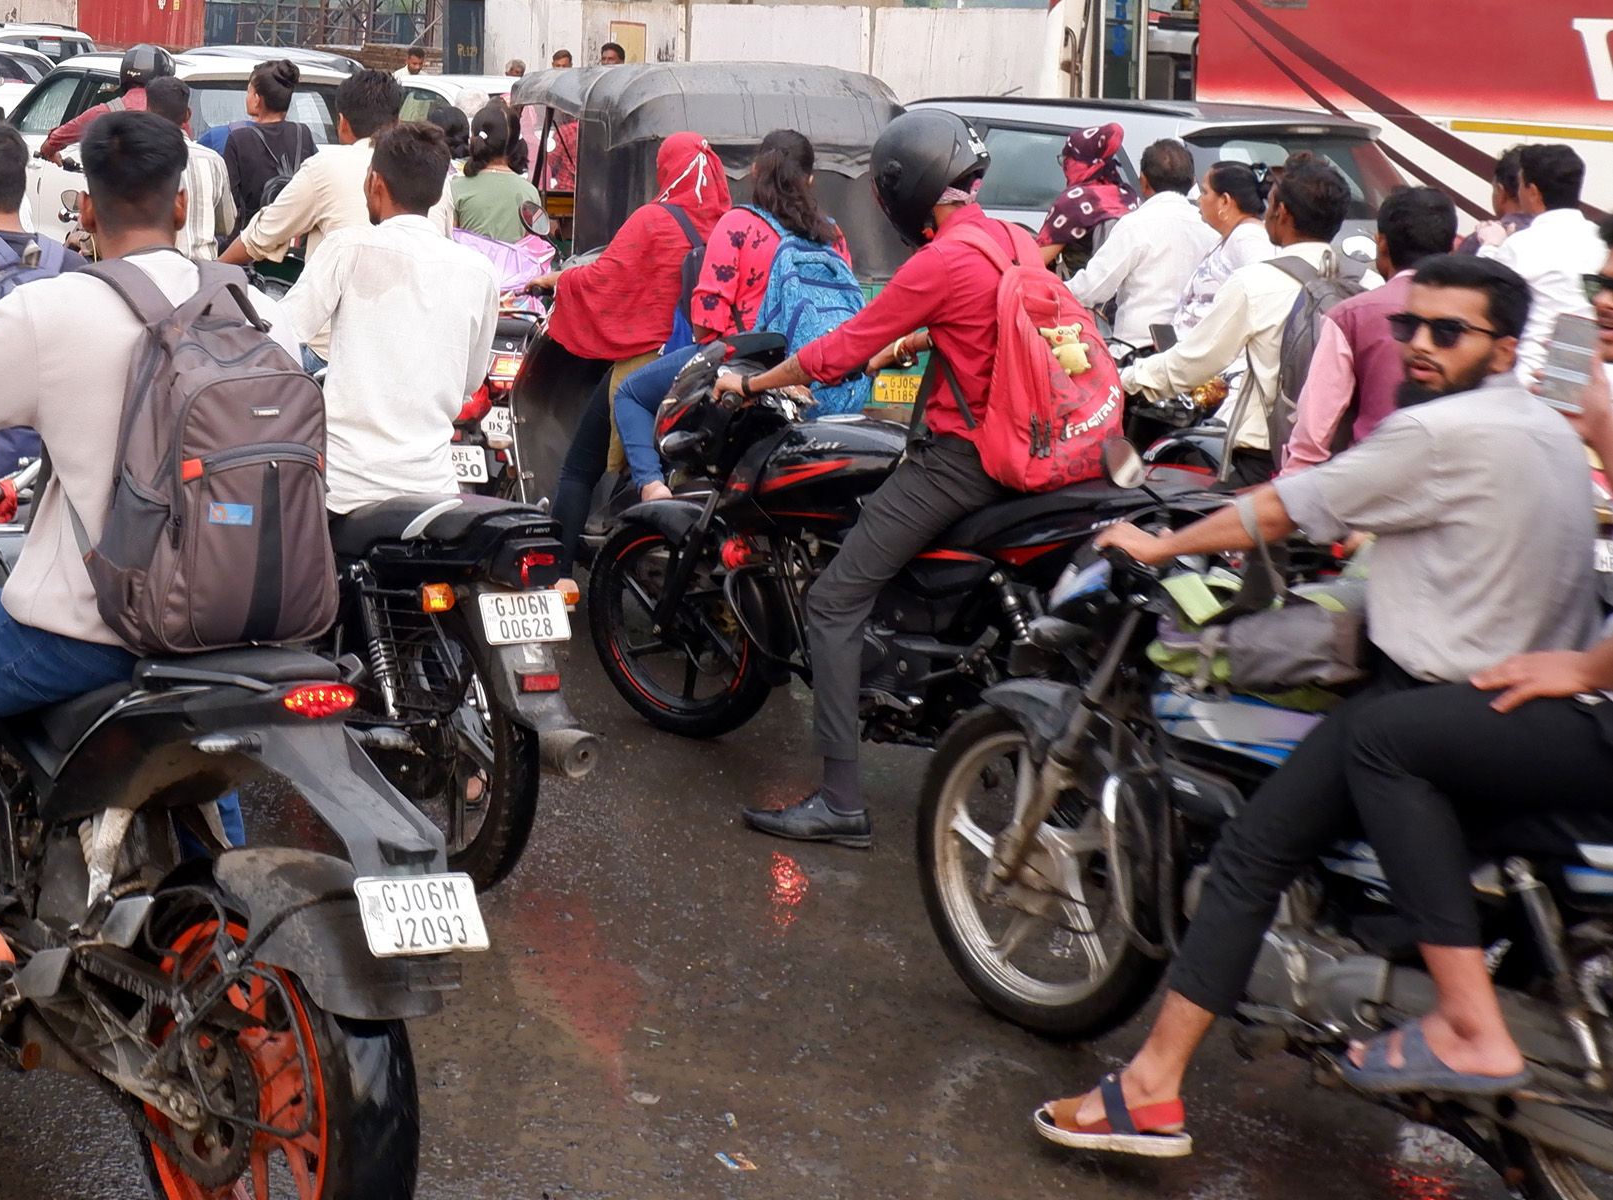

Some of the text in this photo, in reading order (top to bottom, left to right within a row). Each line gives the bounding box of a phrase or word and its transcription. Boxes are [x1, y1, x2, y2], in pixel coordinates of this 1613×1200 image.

[890, 376, 915, 389] GJ06
[495, 595, 549, 617] GJ06N
[381, 881, 459, 913] GJ06M
[394, 915, 468, 949] J2093
